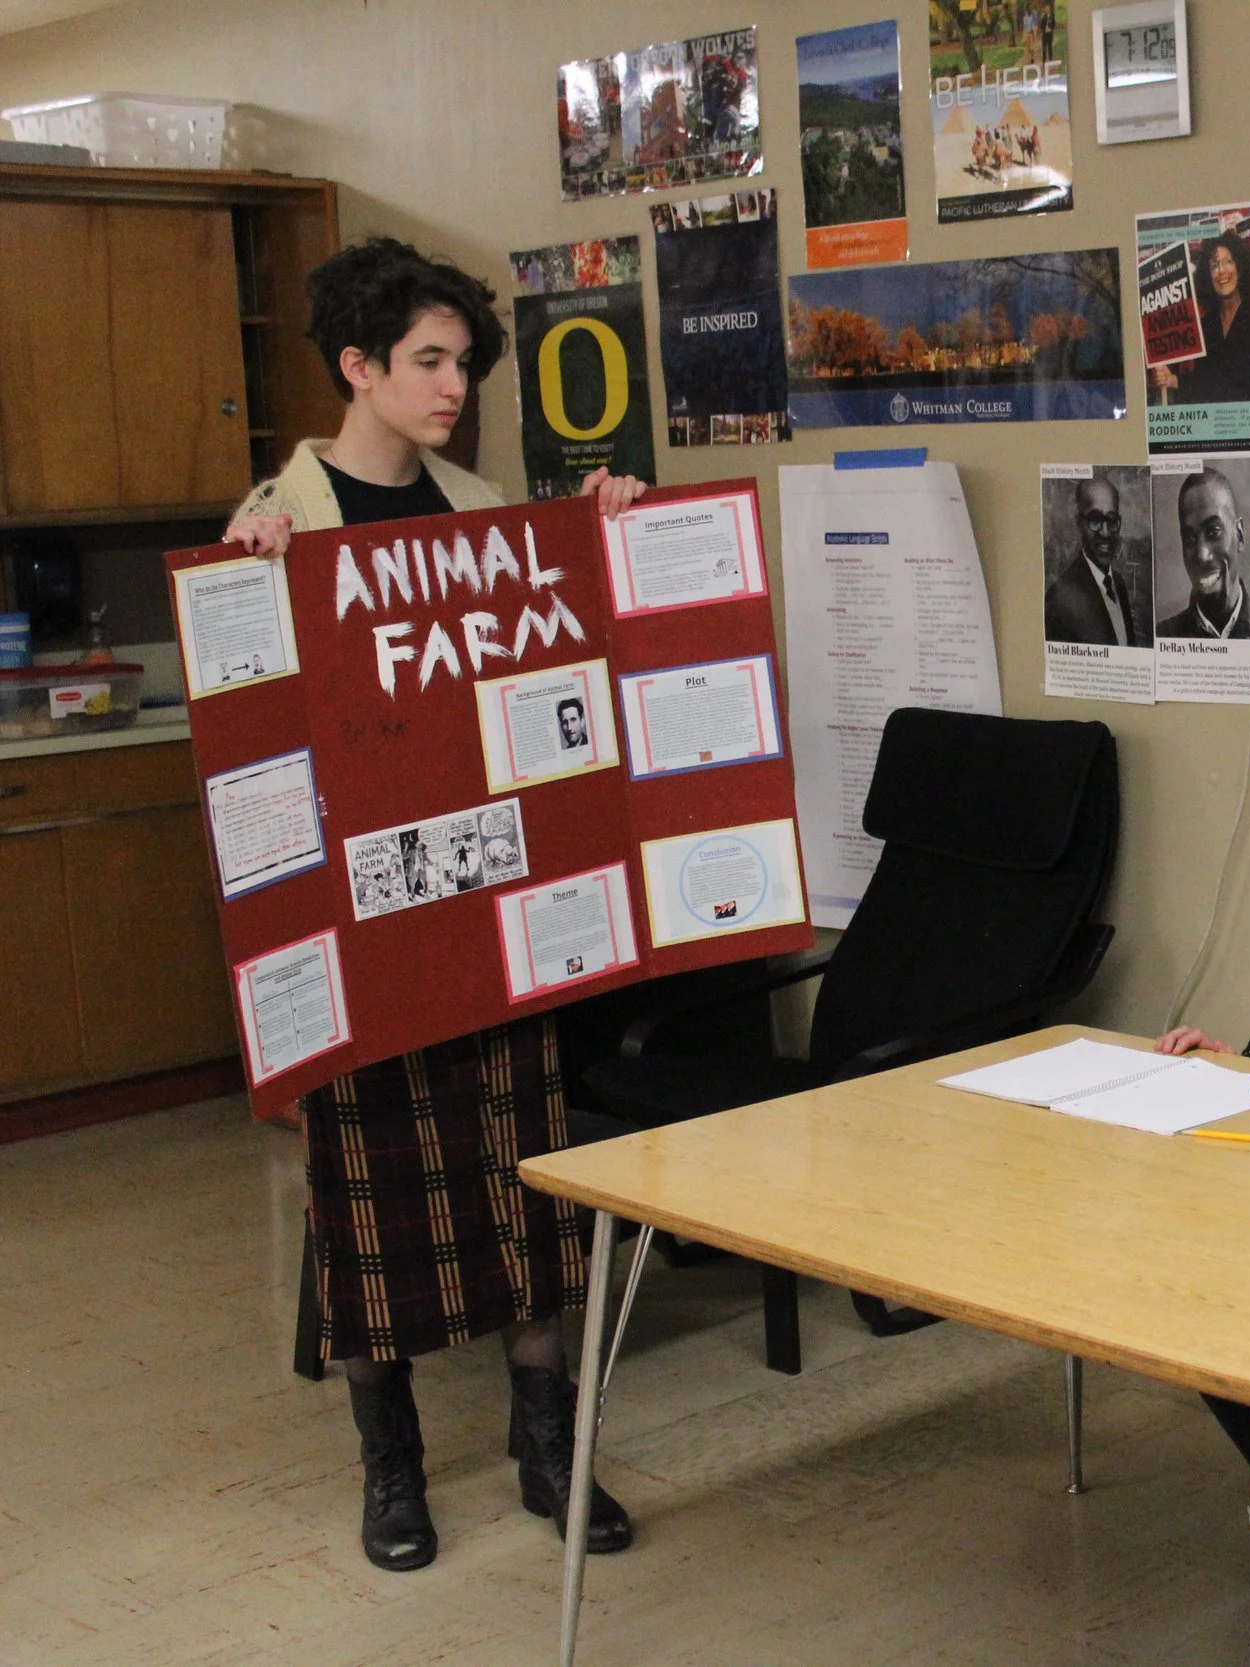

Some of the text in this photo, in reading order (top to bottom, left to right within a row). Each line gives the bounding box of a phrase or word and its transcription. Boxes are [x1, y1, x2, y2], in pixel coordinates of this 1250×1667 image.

[690, 28, 756, 60] WOLVES
[936, 60, 1063, 109] BE HERE
[941, 205, 971, 217] PACIFIC
[973, 200, 1017, 214] LUTHERAN
[1150, 269, 1165, 283] BODY
[1166, 260, 1184, 274] SHOP
[1141, 277, 1188, 315] AGAINST
[682, 311, 758, 334] BE INSPIRED
[1146, 326, 1197, 356] TESTING
[538, 317, 629, 441] O
[912, 399, 1012, 415] WHITMAN COLLEGE
[1149, 410, 1209, 422] DAME ANITA
[1149, 425, 1193, 436] RODDICK
[645, 513, 713, 529] Important Quotes
[335, 521, 567, 622] ANIMAL
[373, 591, 586, 702] FARM
[1048, 645, 1109, 658] David Blackwell
[1159, 643, 1186, 655] DeRay
[685, 677, 706, 687] Plot
[355, 843, 391, 861] ANIMAL
[699, 846, 741, 859] Conclusion
[360, 858, 384, 872] FARM
[552, 888, 578, 901] Theme
